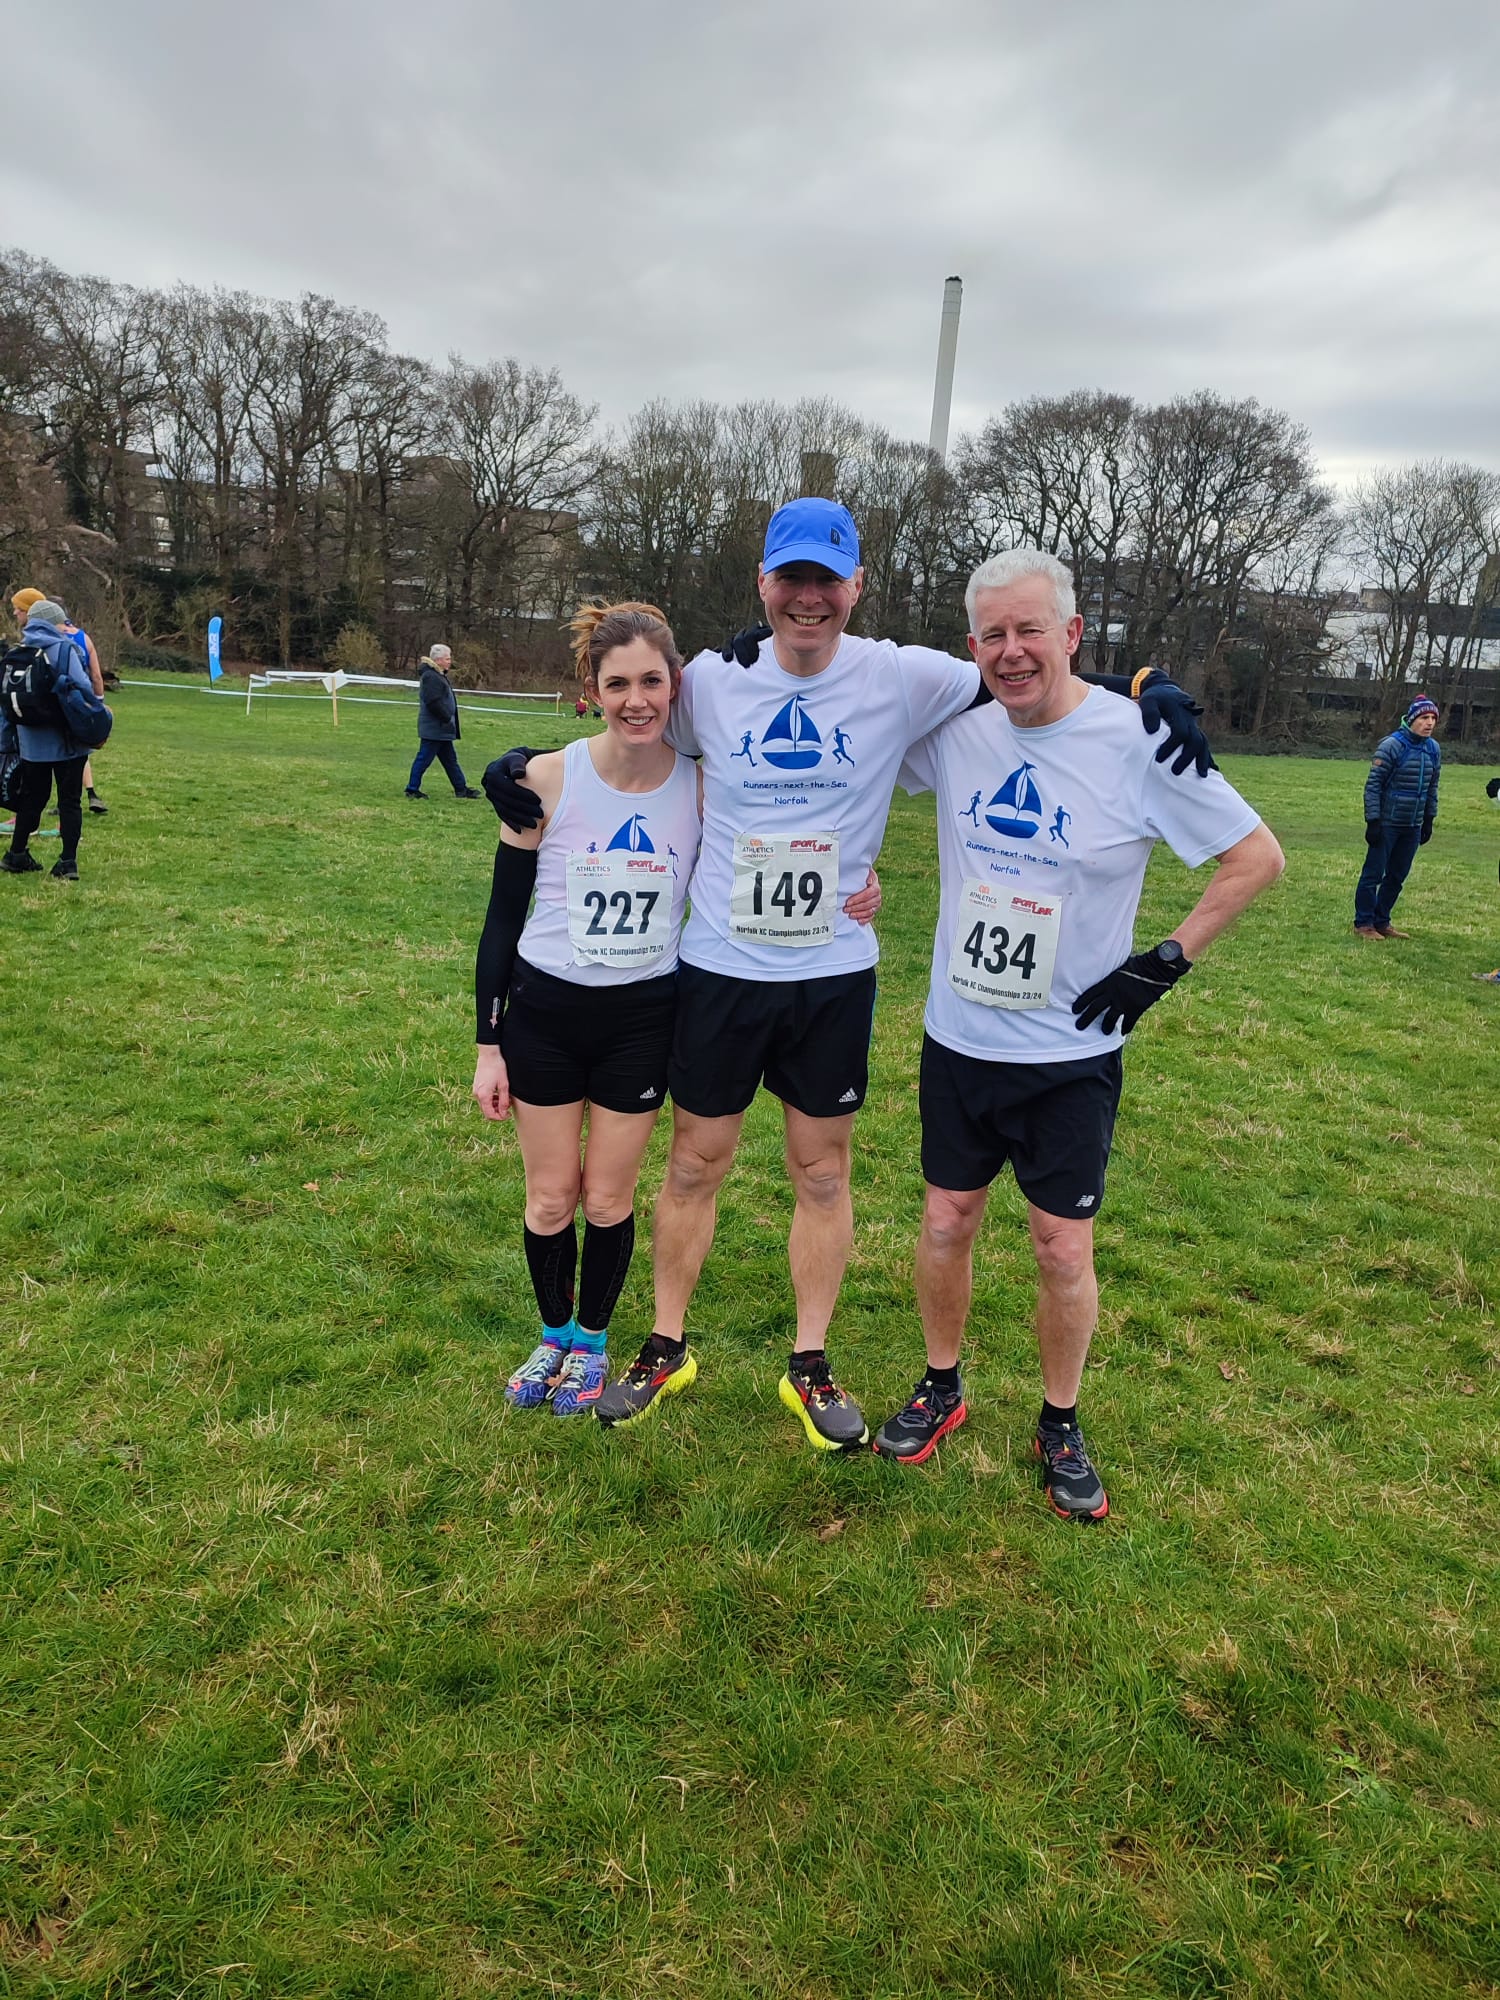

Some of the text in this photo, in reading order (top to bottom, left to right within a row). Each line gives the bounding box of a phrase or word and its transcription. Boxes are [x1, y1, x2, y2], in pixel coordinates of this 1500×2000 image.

[743, 780, 848, 789] Runners-next-the-Sea
[774, 796, 809, 805] Norfolk
[790, 840, 817, 848] SPORT
[966, 840, 1058, 867] Runners-next-the-Sea
[626, 860, 654, 868] SPORT
[990, 863, 1021, 876] Norfolk
[753, 871, 823, 918] 149
[970, 891, 998, 905] ATHLETICS
[1011, 897, 1038, 909] SPORT
[584, 890, 660, 936] 227
[736, 925, 758, 935] Norfolk
[759, 927, 768, 936] XC
[768, 928, 811, 938] Championships
[599, 947, 608, 956] XC
[609, 947, 649, 957] Championships
[963, 920, 1036, 980] 434
[951, 974, 969, 987] Norfolk
[977, 982, 1021, 1000] Championships
[1022, 991, 1042, 1001] 23/24
